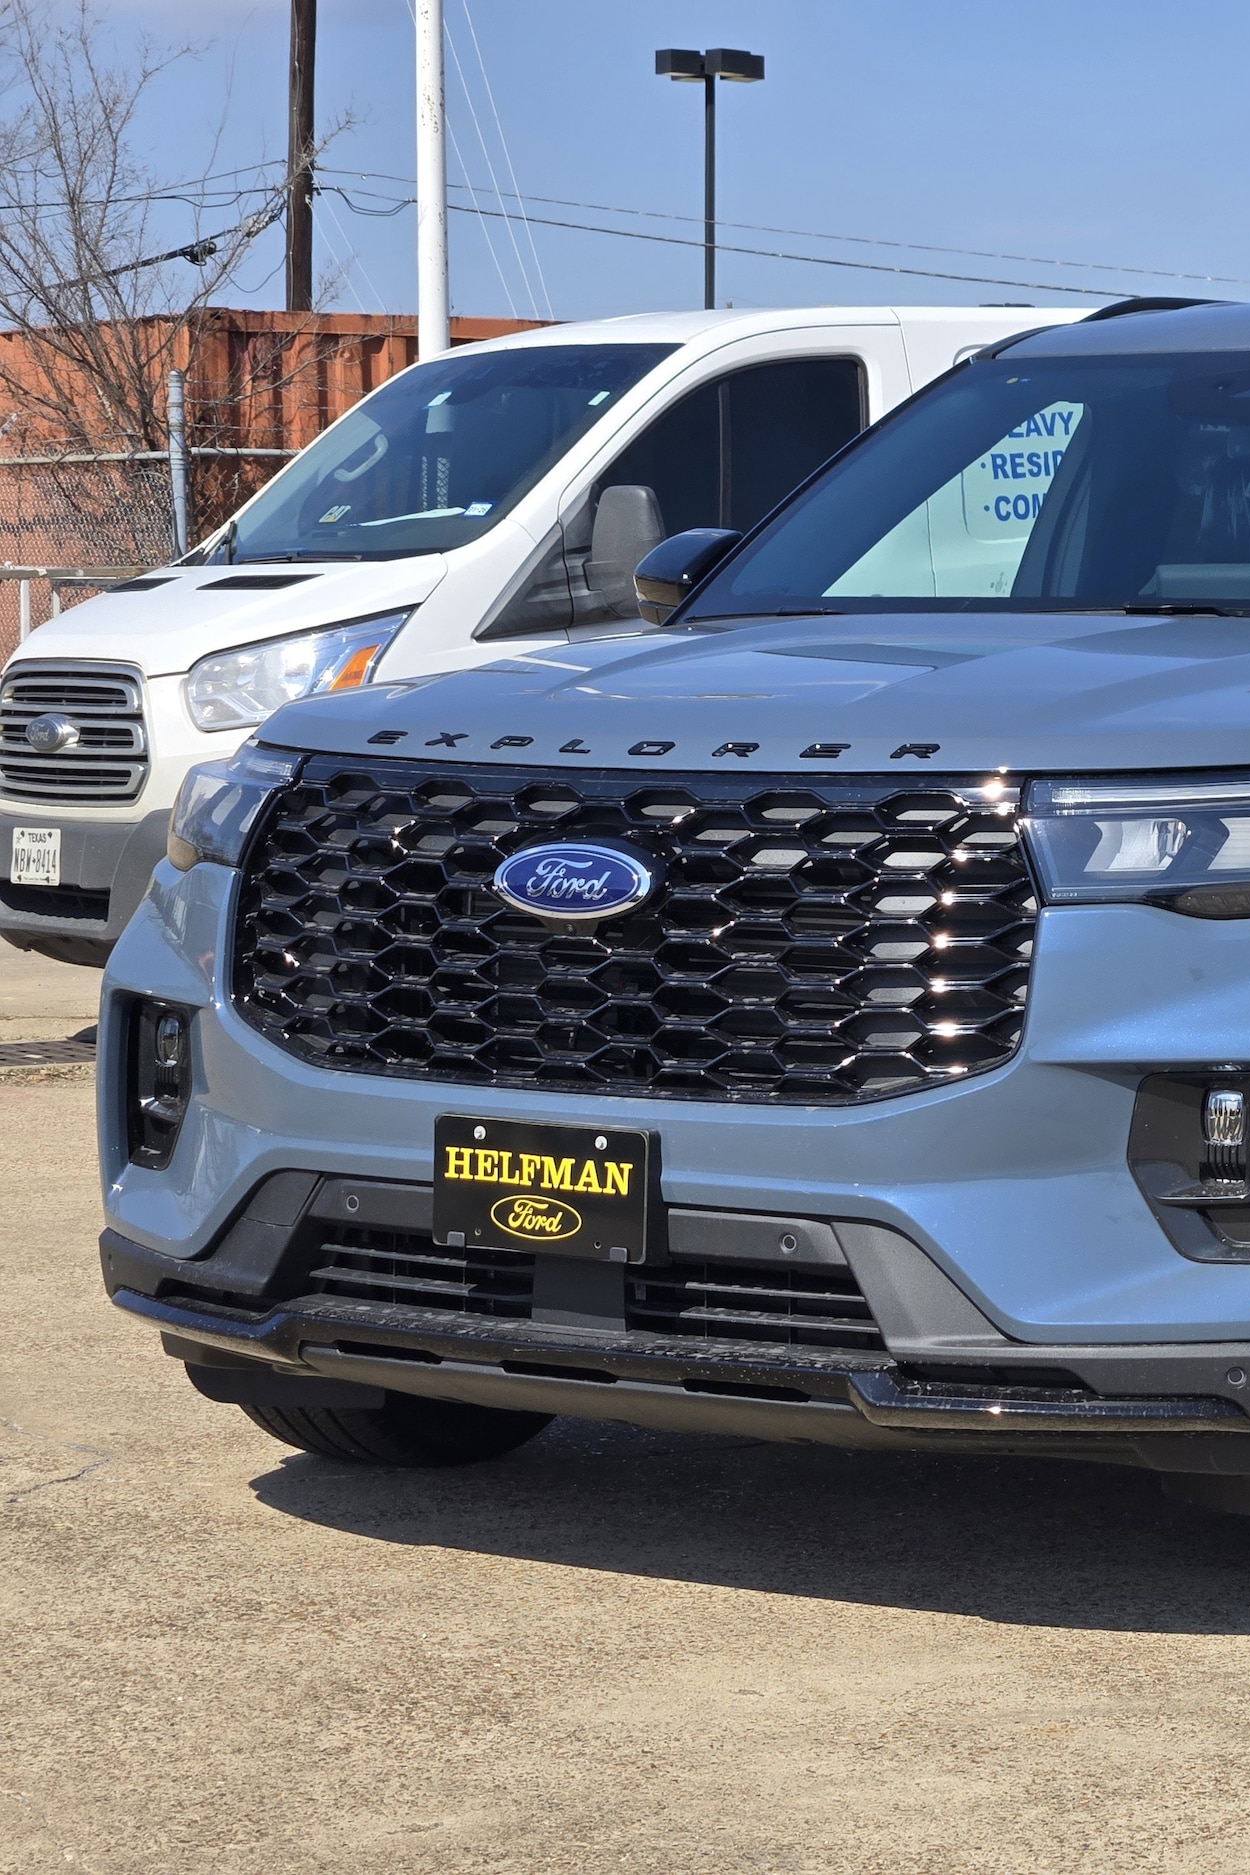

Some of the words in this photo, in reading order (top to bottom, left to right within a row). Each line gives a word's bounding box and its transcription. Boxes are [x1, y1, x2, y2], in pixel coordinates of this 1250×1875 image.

[30, 722, 50, 741] Ford
[366, 730, 942, 760] EXPLORER
[28, 832, 47, 843] TEXAS
[526, 857, 611, 900] Ford
[444, 1146, 634, 1196] HELFMAN
[508, 1199, 564, 1233] Ford
